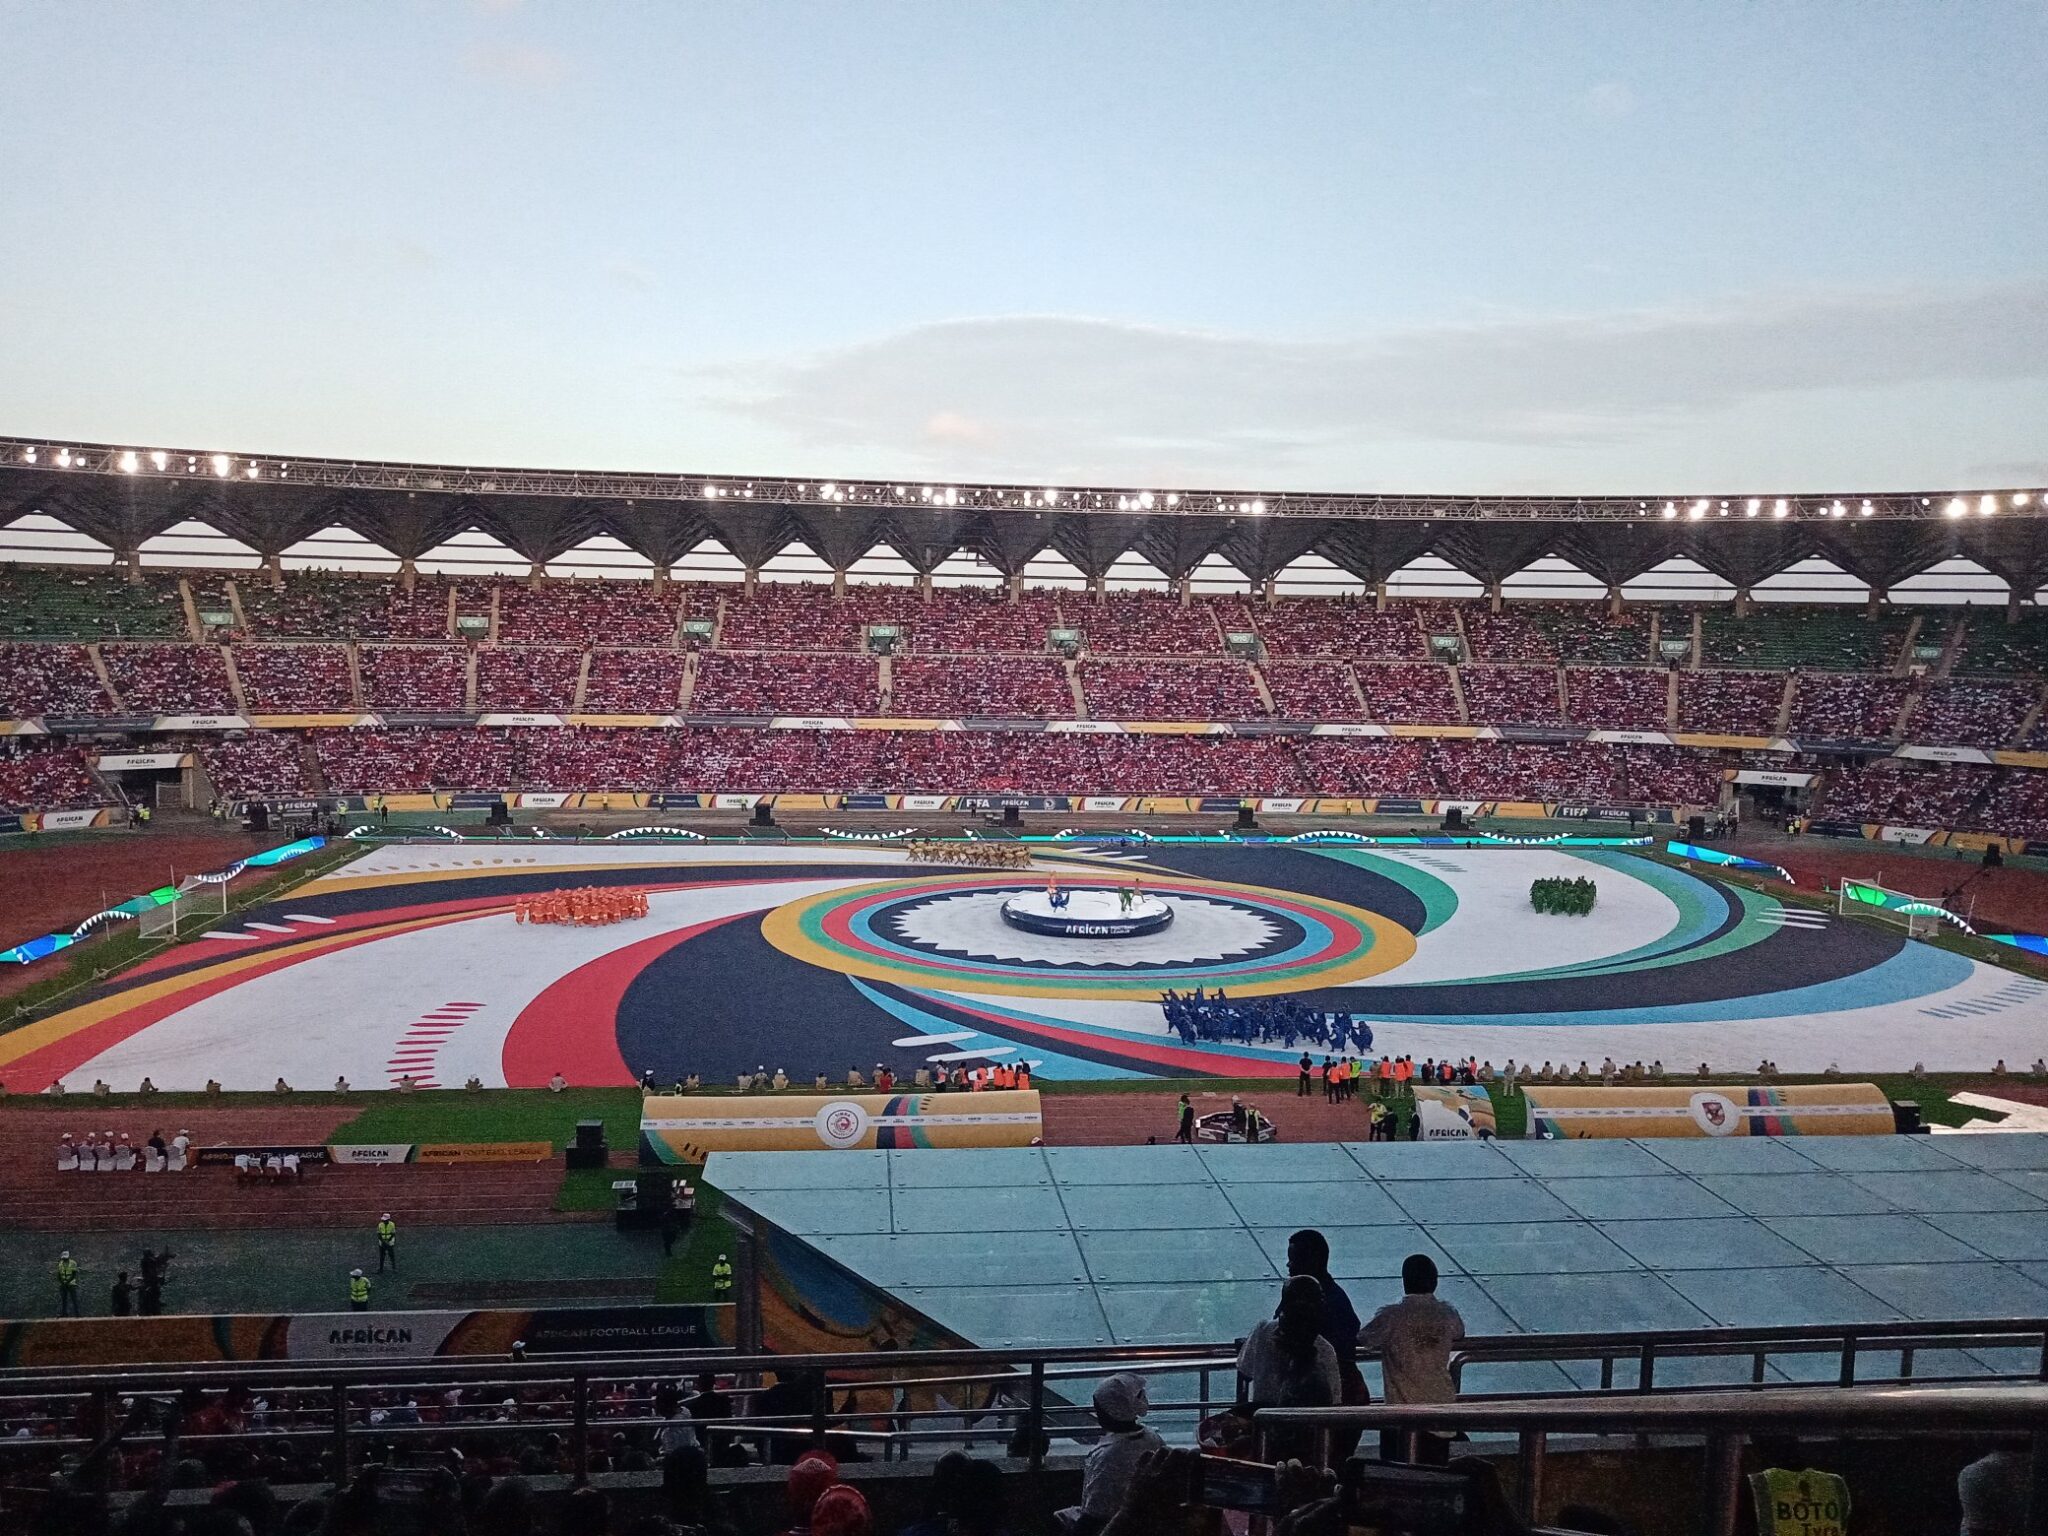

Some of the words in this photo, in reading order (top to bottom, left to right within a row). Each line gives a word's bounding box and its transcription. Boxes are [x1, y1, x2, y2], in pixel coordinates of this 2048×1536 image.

[1065, 923, 1108, 934] AFRICAN
[1429, 1127, 1468, 1137] AFRICAN
[329, 1325, 412, 1343] AFRICAN
[590, 1327, 650, 1338] FOOTBALL
[652, 1325, 697, 1336] LEAGUE
